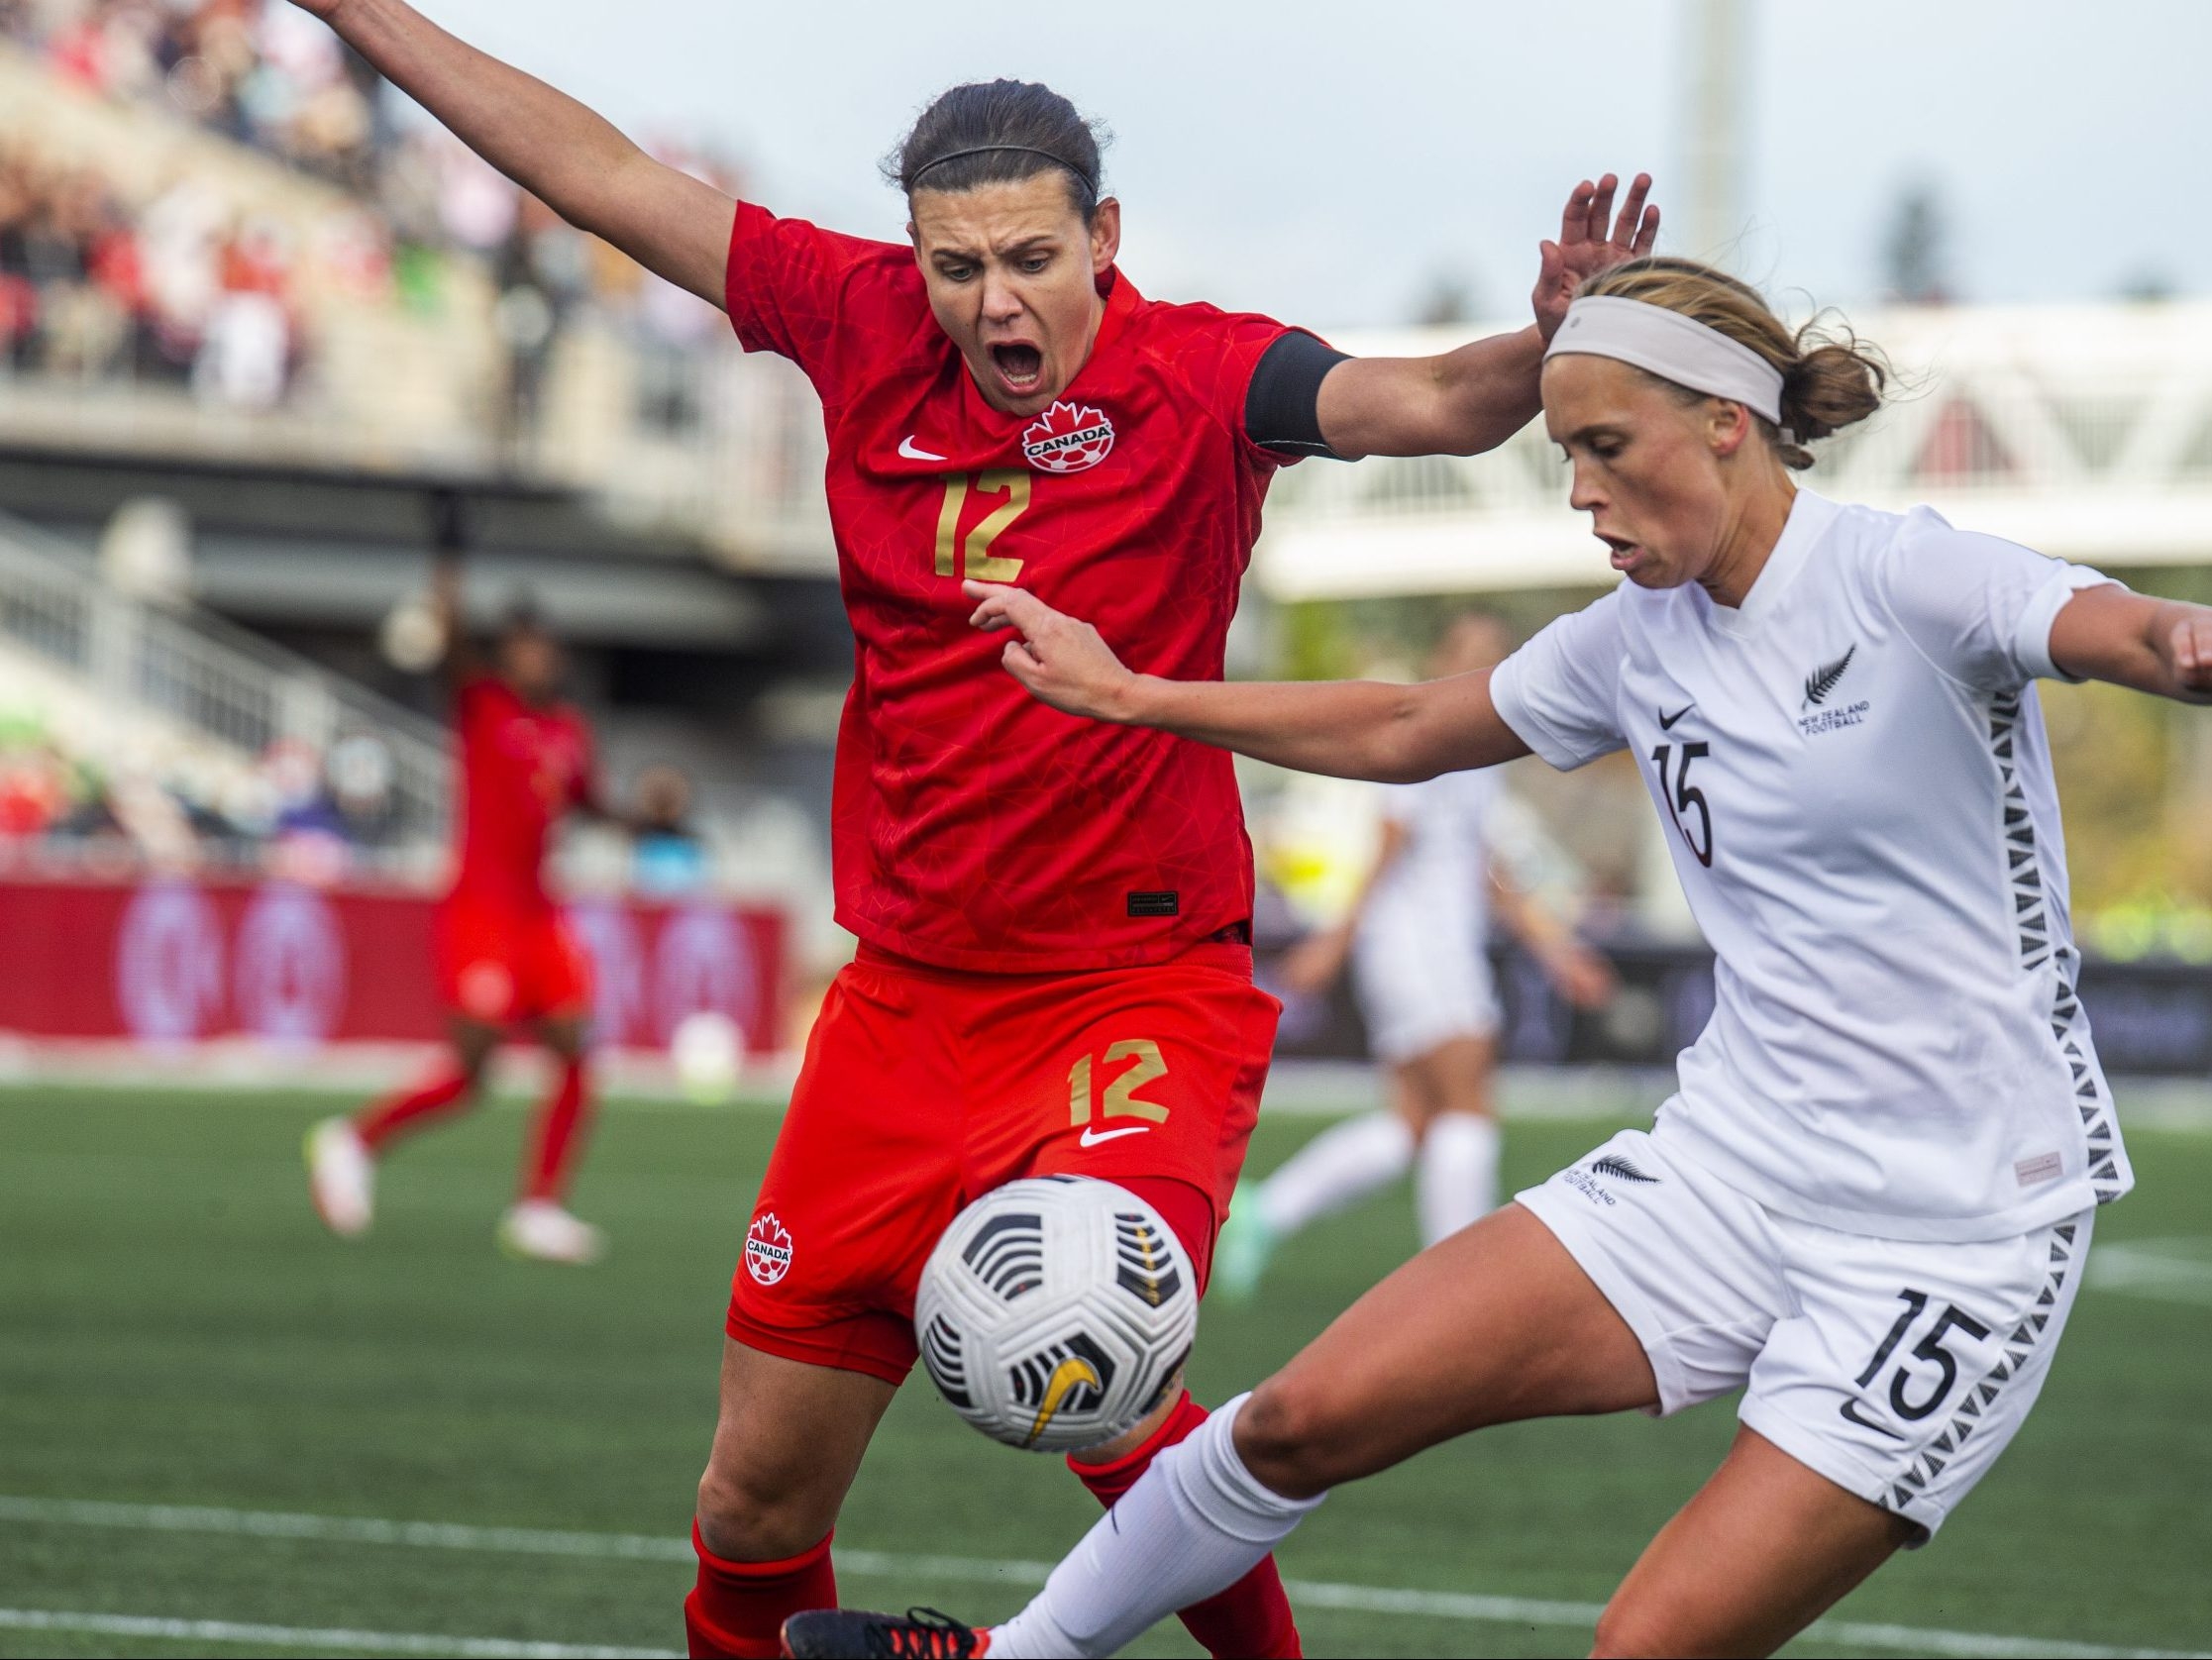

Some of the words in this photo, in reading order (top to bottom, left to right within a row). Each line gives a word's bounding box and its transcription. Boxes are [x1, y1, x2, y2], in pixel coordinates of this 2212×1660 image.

[1027, 426, 1110, 457] CANADA
[935, 467, 1031, 582] 12
[1798, 715, 1819, 727] NEW
[1822, 700, 1870, 722] ZEALAND
[1805, 712, 1863, 735] FOOTBALL
[1650, 741, 1713, 869] 15
[1067, 1038, 1170, 1127] 12
[747, 1240, 789, 1261] CANADA
[1854, 1287, 1991, 1420] 15
